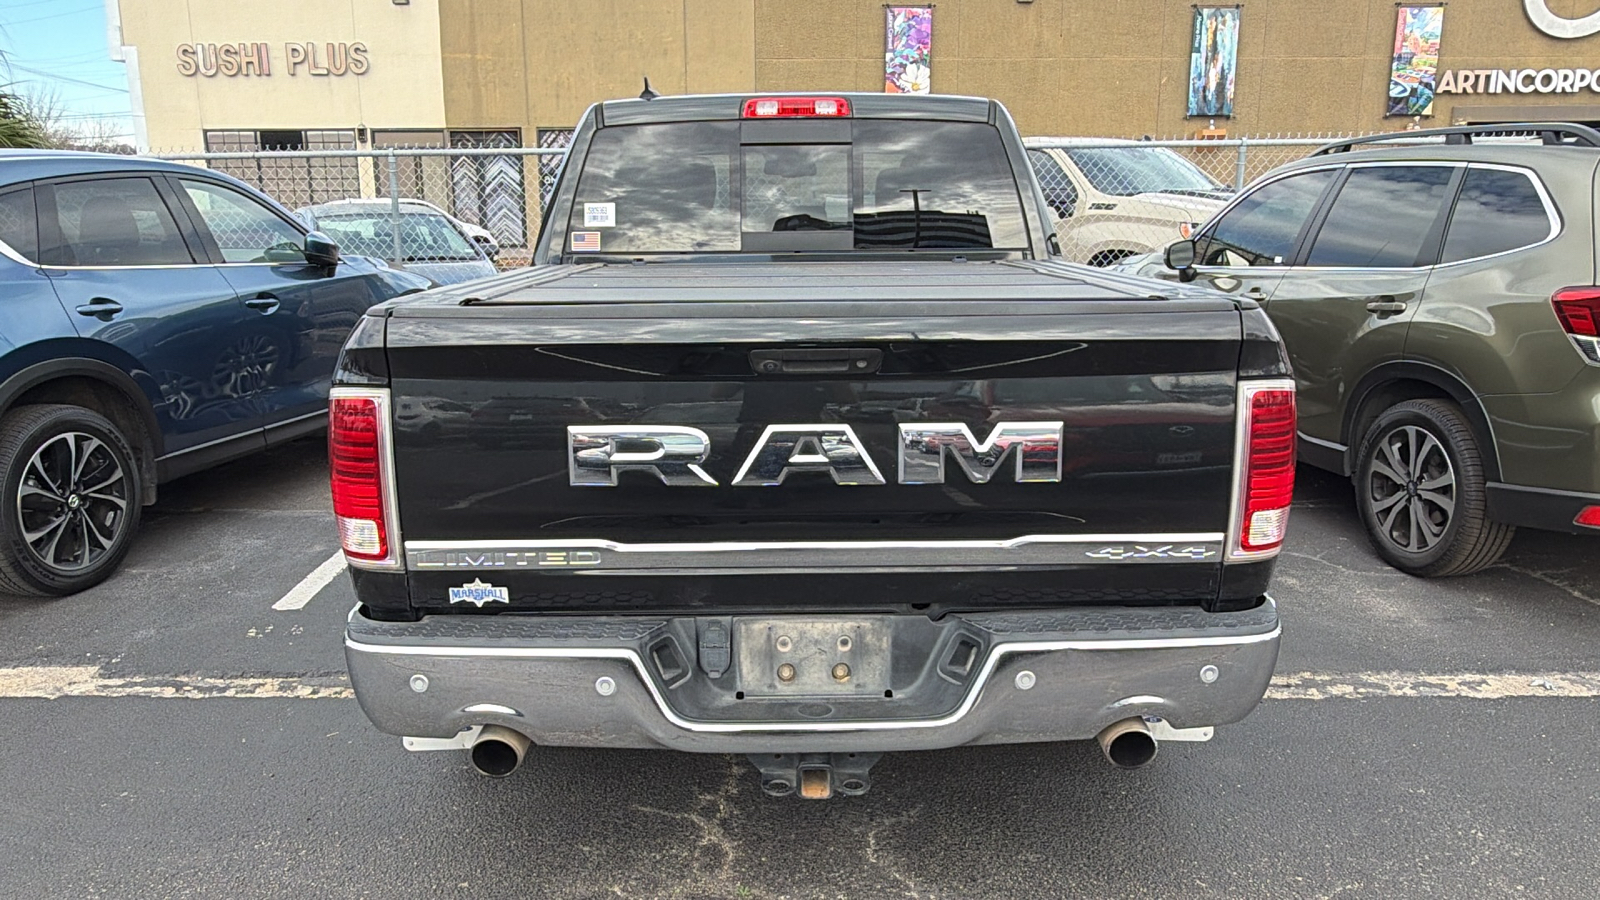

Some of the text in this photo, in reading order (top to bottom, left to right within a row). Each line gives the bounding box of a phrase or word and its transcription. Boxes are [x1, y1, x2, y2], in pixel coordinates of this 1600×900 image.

[176, 42, 370, 77] SUSHI PLUS
[567, 422, 1064, 487] RAM
[416, 551, 601, 567] LIMITED
[450, 588, 507, 601] MARSHALL
